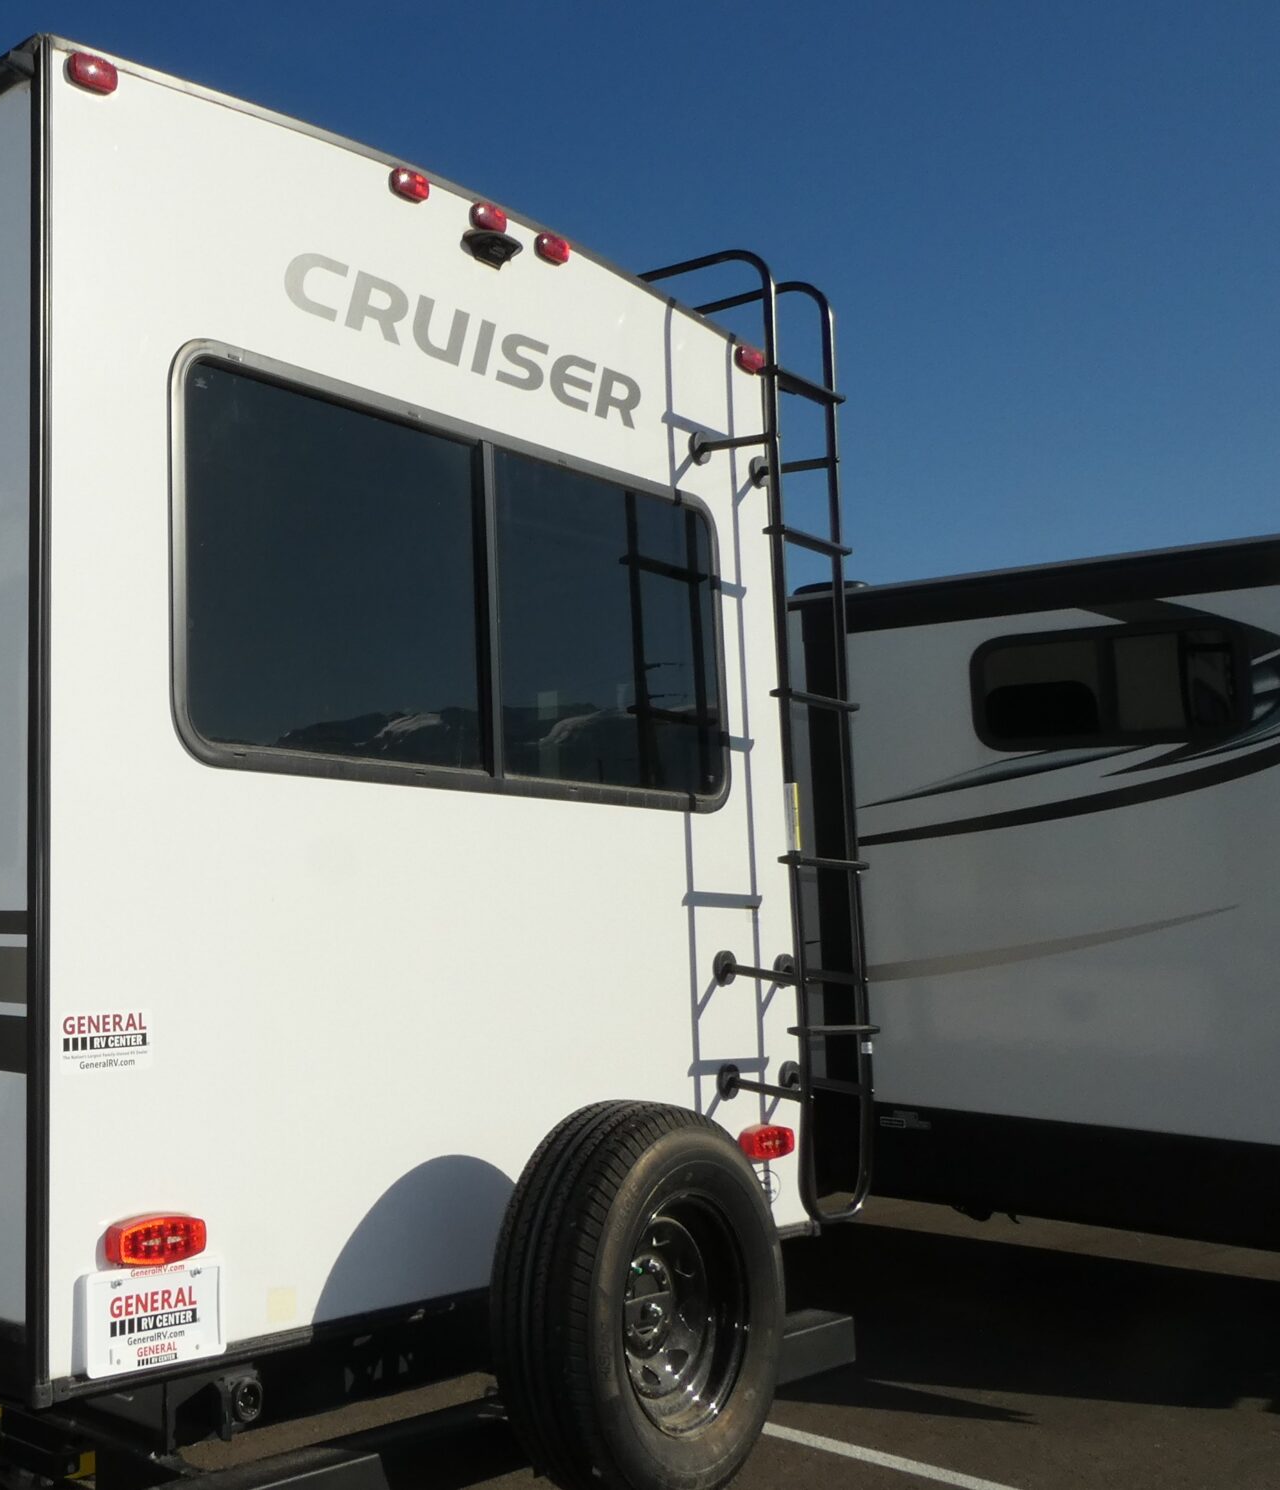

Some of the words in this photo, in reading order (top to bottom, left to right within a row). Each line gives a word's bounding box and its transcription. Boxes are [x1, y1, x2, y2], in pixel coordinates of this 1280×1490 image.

[284, 253, 642, 429] CRUISER
[62, 1012, 147, 1035] GENERAL
[93, 1037, 107, 1049] RV
[108, 1035, 143, 1048] CENTER
[80, 1059, 135, 1070] GeneralRV.com
[130, 1263, 185, 1278] GeneralRV.com
[110, 1285, 197, 1319] GENERAL
[141, 1317, 155, 1330] RV
[156, 1311, 193, 1327] CENTER
[127, 1330, 185, 1346] GeneralRV.com
[137, 1341, 177, 1358] GENERAL
